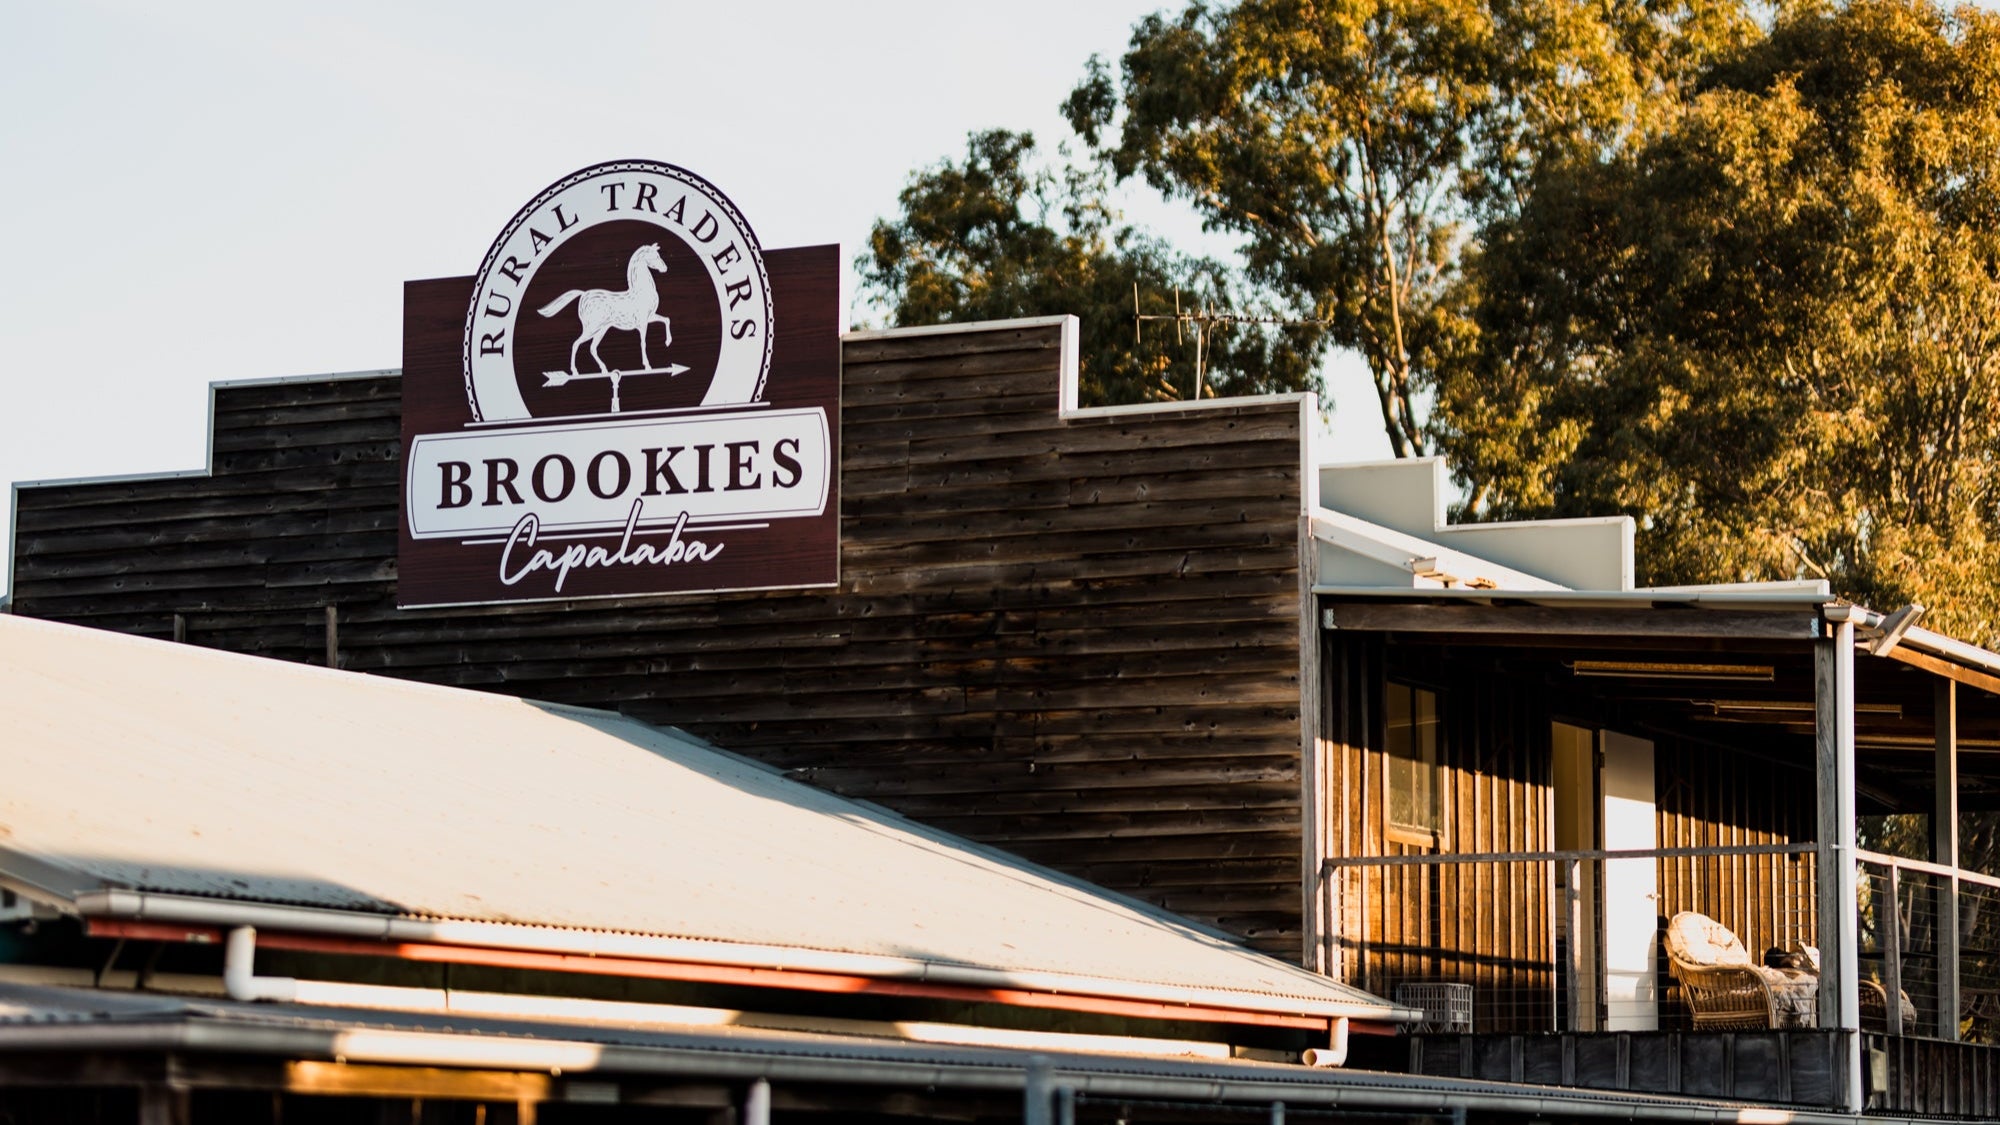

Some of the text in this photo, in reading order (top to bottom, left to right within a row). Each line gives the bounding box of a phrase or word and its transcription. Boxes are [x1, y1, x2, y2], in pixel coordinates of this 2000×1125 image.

[480, 182, 756, 358] RURAL TRADERS
[436, 438, 802, 509] BROOKIES
[500, 498, 724, 592] Capalaba
